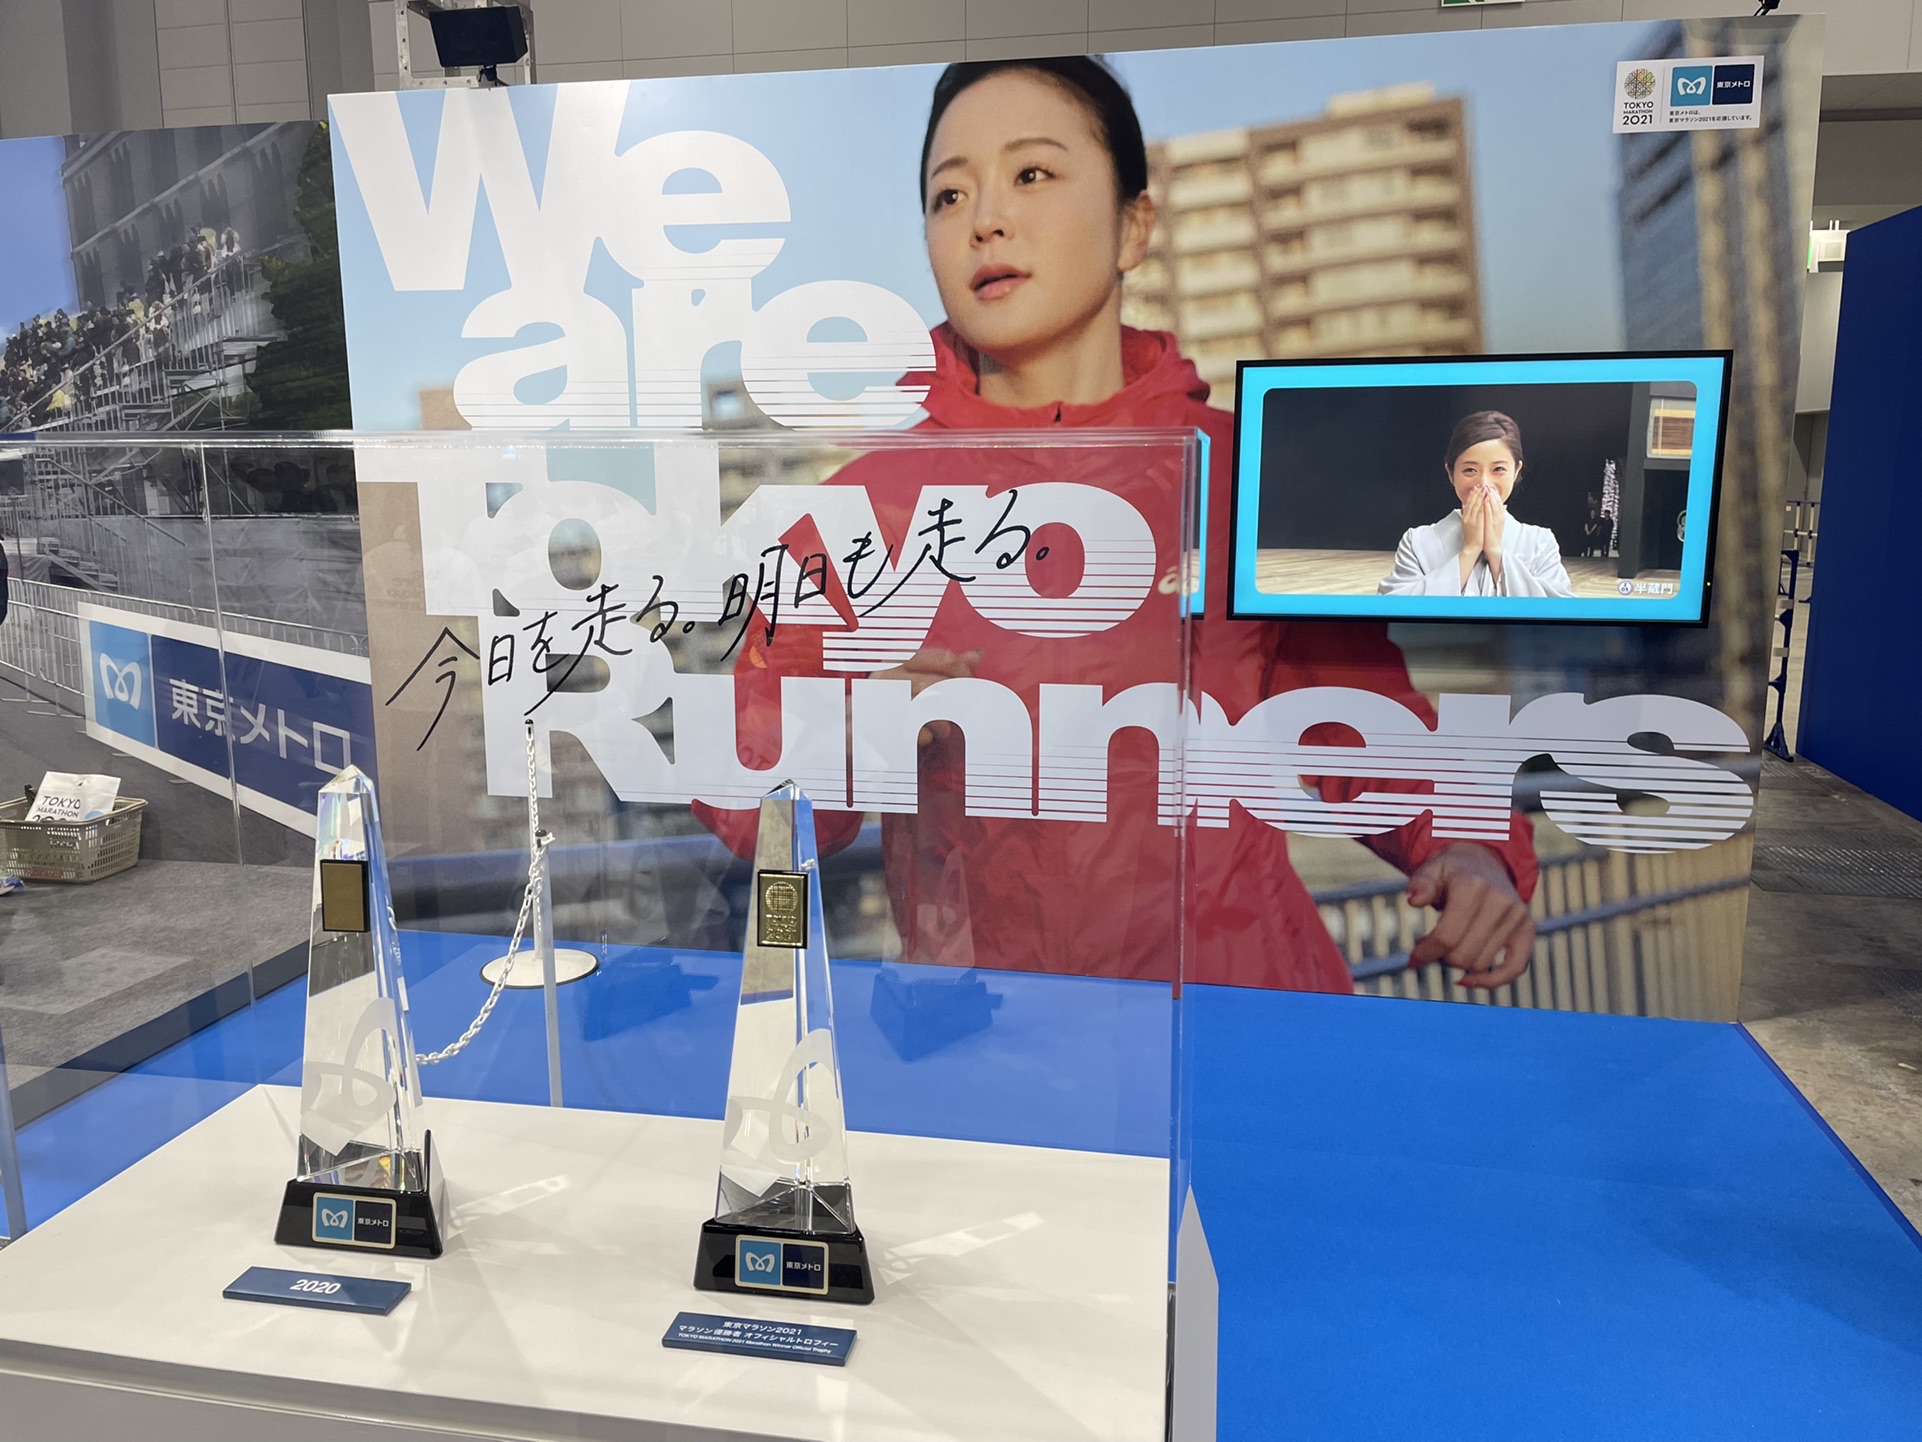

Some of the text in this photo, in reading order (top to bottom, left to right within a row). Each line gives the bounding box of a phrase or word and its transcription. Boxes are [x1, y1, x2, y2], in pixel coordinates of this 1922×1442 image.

[1716, 80, 1750, 88] 東京メトロ
[1623, 101, 1654, 109] TOKYO
[1622, 114, 1653, 125] 2021
[330, 80, 792, 292] We
[453, 280, 936, 432] are
[355, 434, 1156, 672] Tokyo
[1634, 582, 1674, 595] 半蔵門
[169, 678, 351, 775] 東京メトロ
[487, 614, 1754, 854] Runners
[41, 795, 81, 809] TOKYO
[37, 807, 80, 818] MARATHON
[357, 1217, 389, 1227] 東京メトロ
[786, 1261, 821, 1271] 東京メトロ
[290, 1279, 341, 1294] 2020
[722, 1321, 802, 1335] 東京マラソン2021
[698, 1334, 731, 1343] MARATHON
